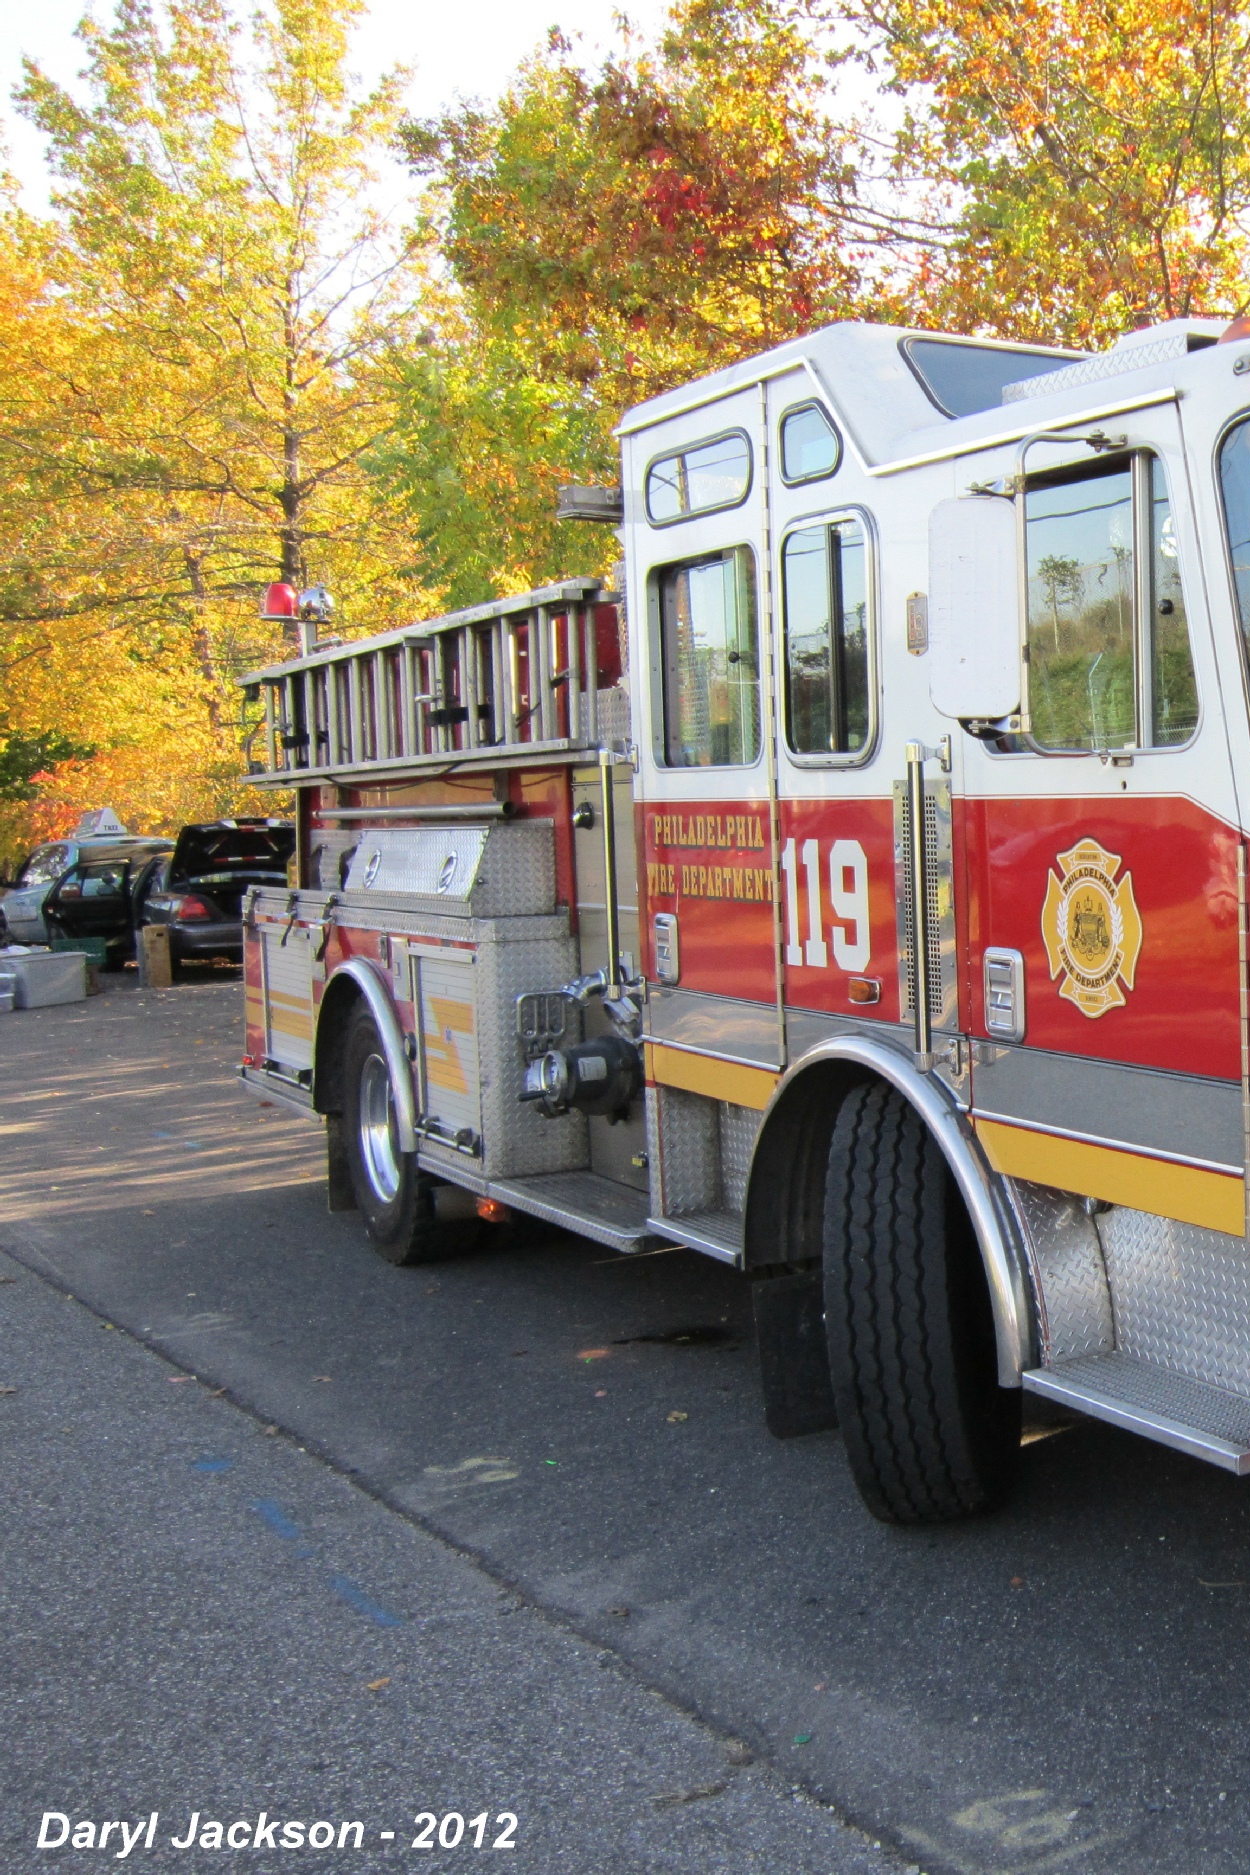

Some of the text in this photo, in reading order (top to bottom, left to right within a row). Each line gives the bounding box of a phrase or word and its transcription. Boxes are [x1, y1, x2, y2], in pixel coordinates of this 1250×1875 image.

[655, 816, 764, 848] PHILADELPHIA
[682, 865, 774, 902] DEPARTMENT
[1063, 868, 1115, 897] PHILADELPHIA
[782, 838, 870, 972] 119
[1061, 949, 1122, 987] FIRE DEPARTMENT
